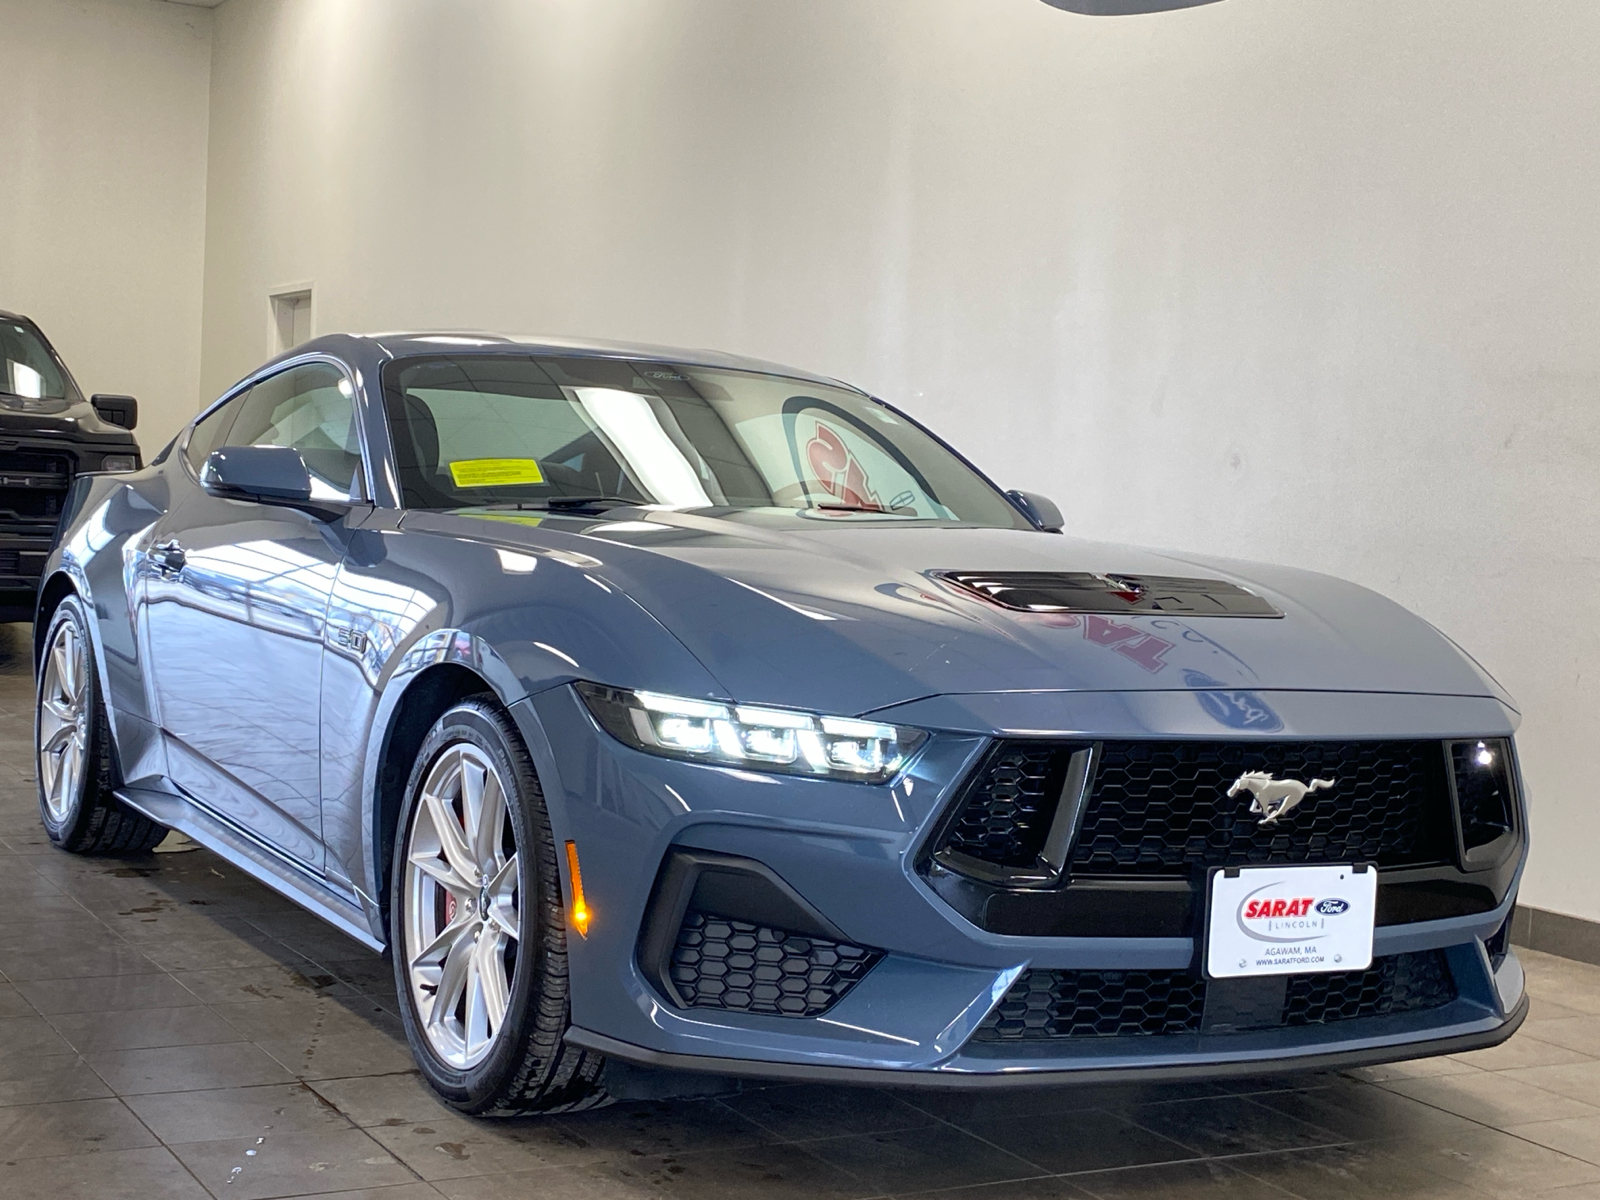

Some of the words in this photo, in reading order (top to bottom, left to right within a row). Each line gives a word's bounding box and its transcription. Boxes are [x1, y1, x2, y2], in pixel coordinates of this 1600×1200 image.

[1245, 898, 1315, 919] SARAT
[1319, 899, 1345, 914] Ford
[1275, 921, 1318, 929] LINCOLN
[1265, 947, 1302, 956] AGAWAM,
[1304, 946, 1317, 954] MA
[1256, 956, 1324, 966] WWW.SARATFORD.COM
